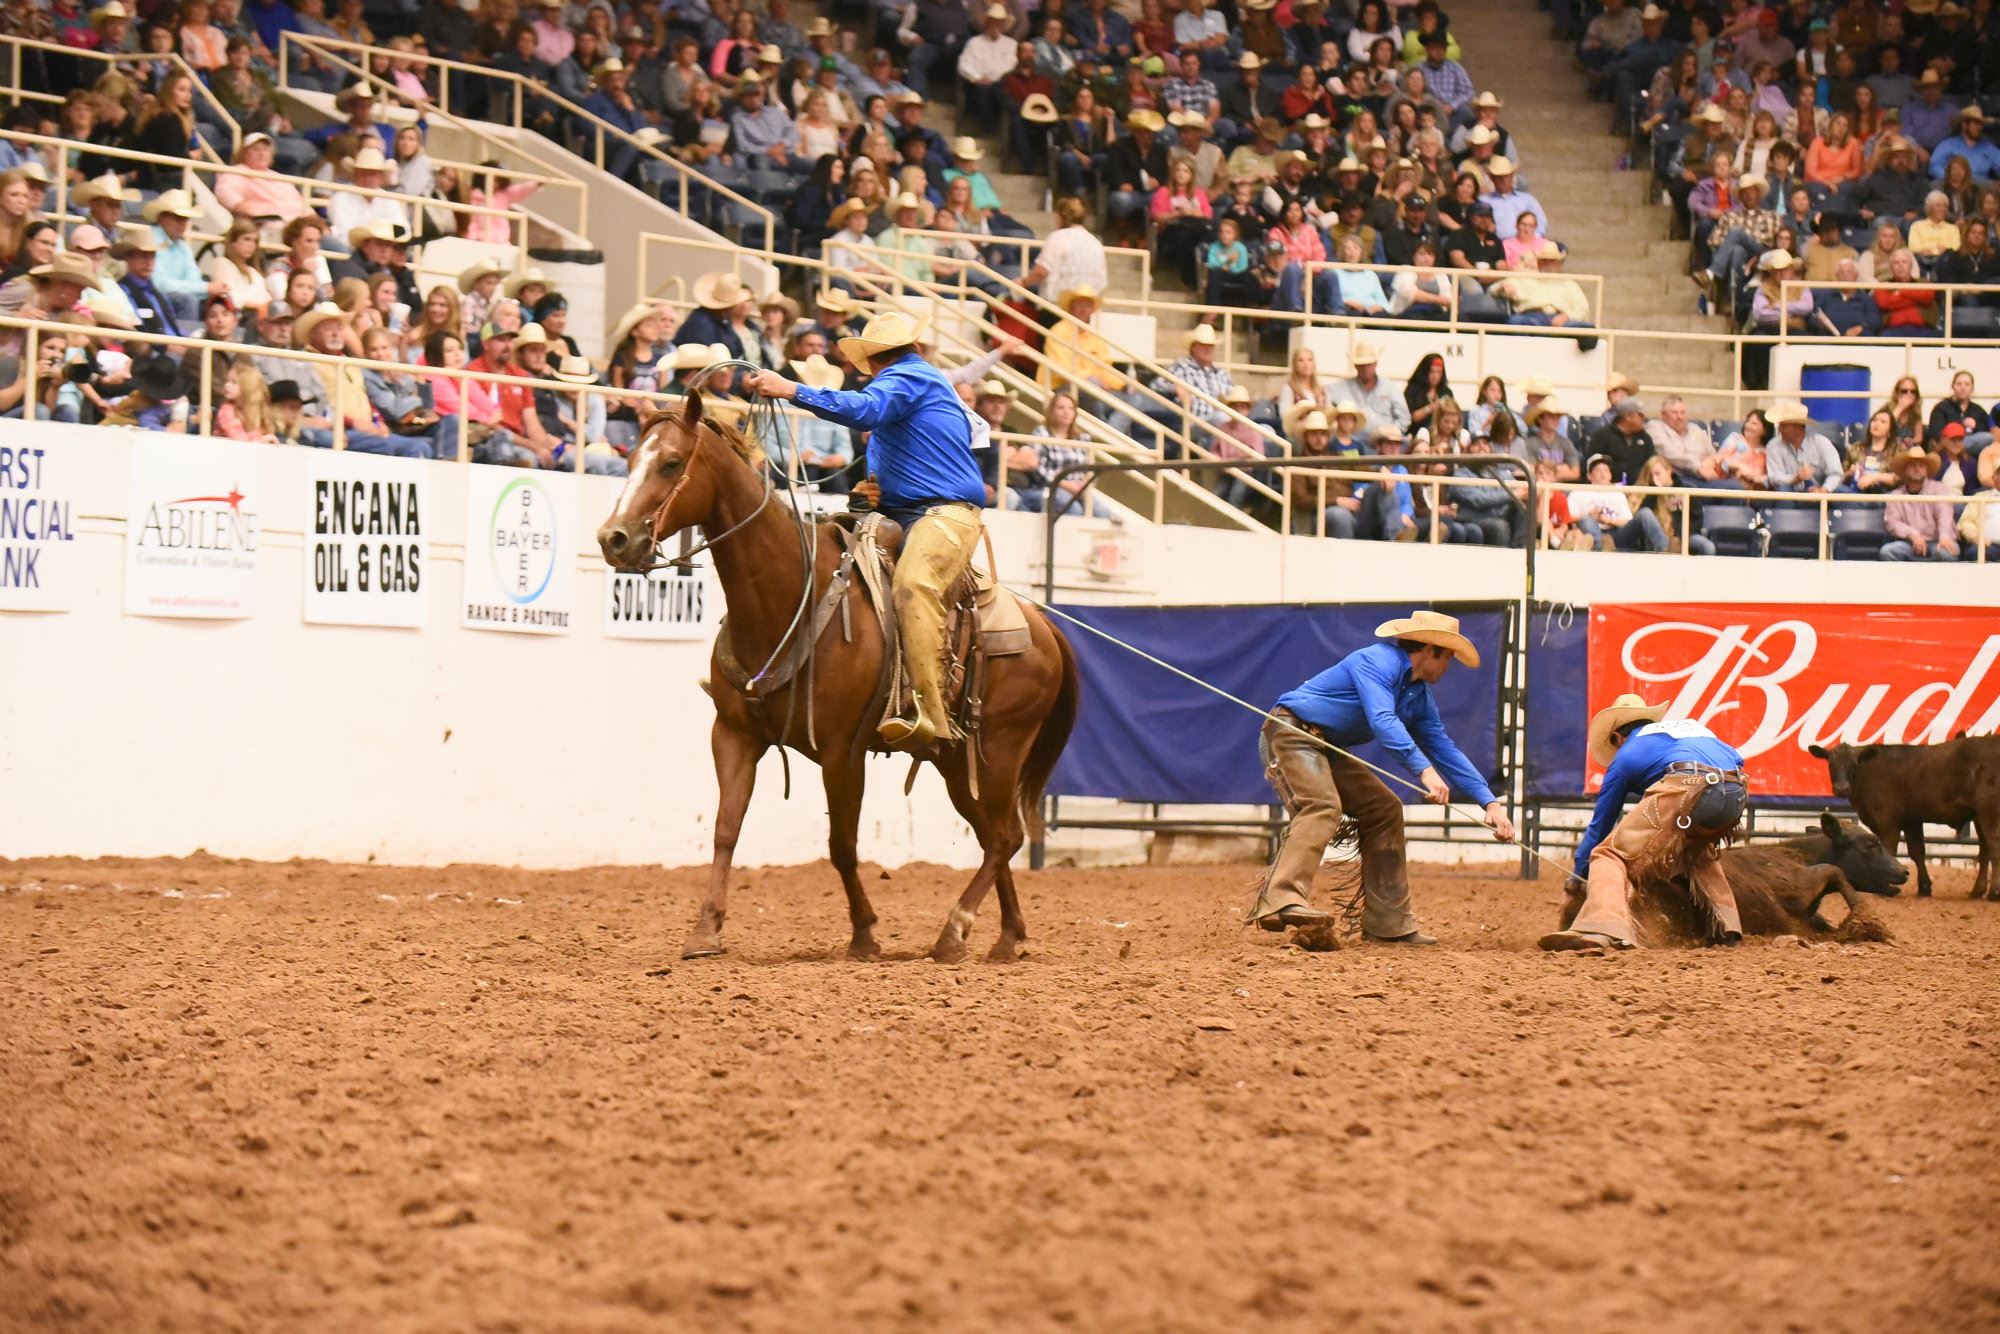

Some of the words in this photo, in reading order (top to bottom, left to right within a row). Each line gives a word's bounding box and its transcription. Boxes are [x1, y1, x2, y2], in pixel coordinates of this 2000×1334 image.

[1446, 343, 1464, 358] KK
[1938, 356, 1957, 370] LL
[0, 447, 45, 489] RST
[0, 498, 74, 541] NCIAL
[136, 500, 257, 552] ABILENE
[315, 480, 420, 535] ENCANA
[496, 529, 552, 551] BAYER
[519, 489, 532, 592] BAYER
[315, 542, 348, 592] OIL
[358, 543, 370, 592] &
[380, 543, 420, 592] GAS
[467, 604, 507, 622] RANGE
[511, 607, 518, 623] &
[522, 608, 569, 627] PASTURE
[613, 578, 704, 623] SOLUTIONS
[1621, 619, 2000, 760] Bud
